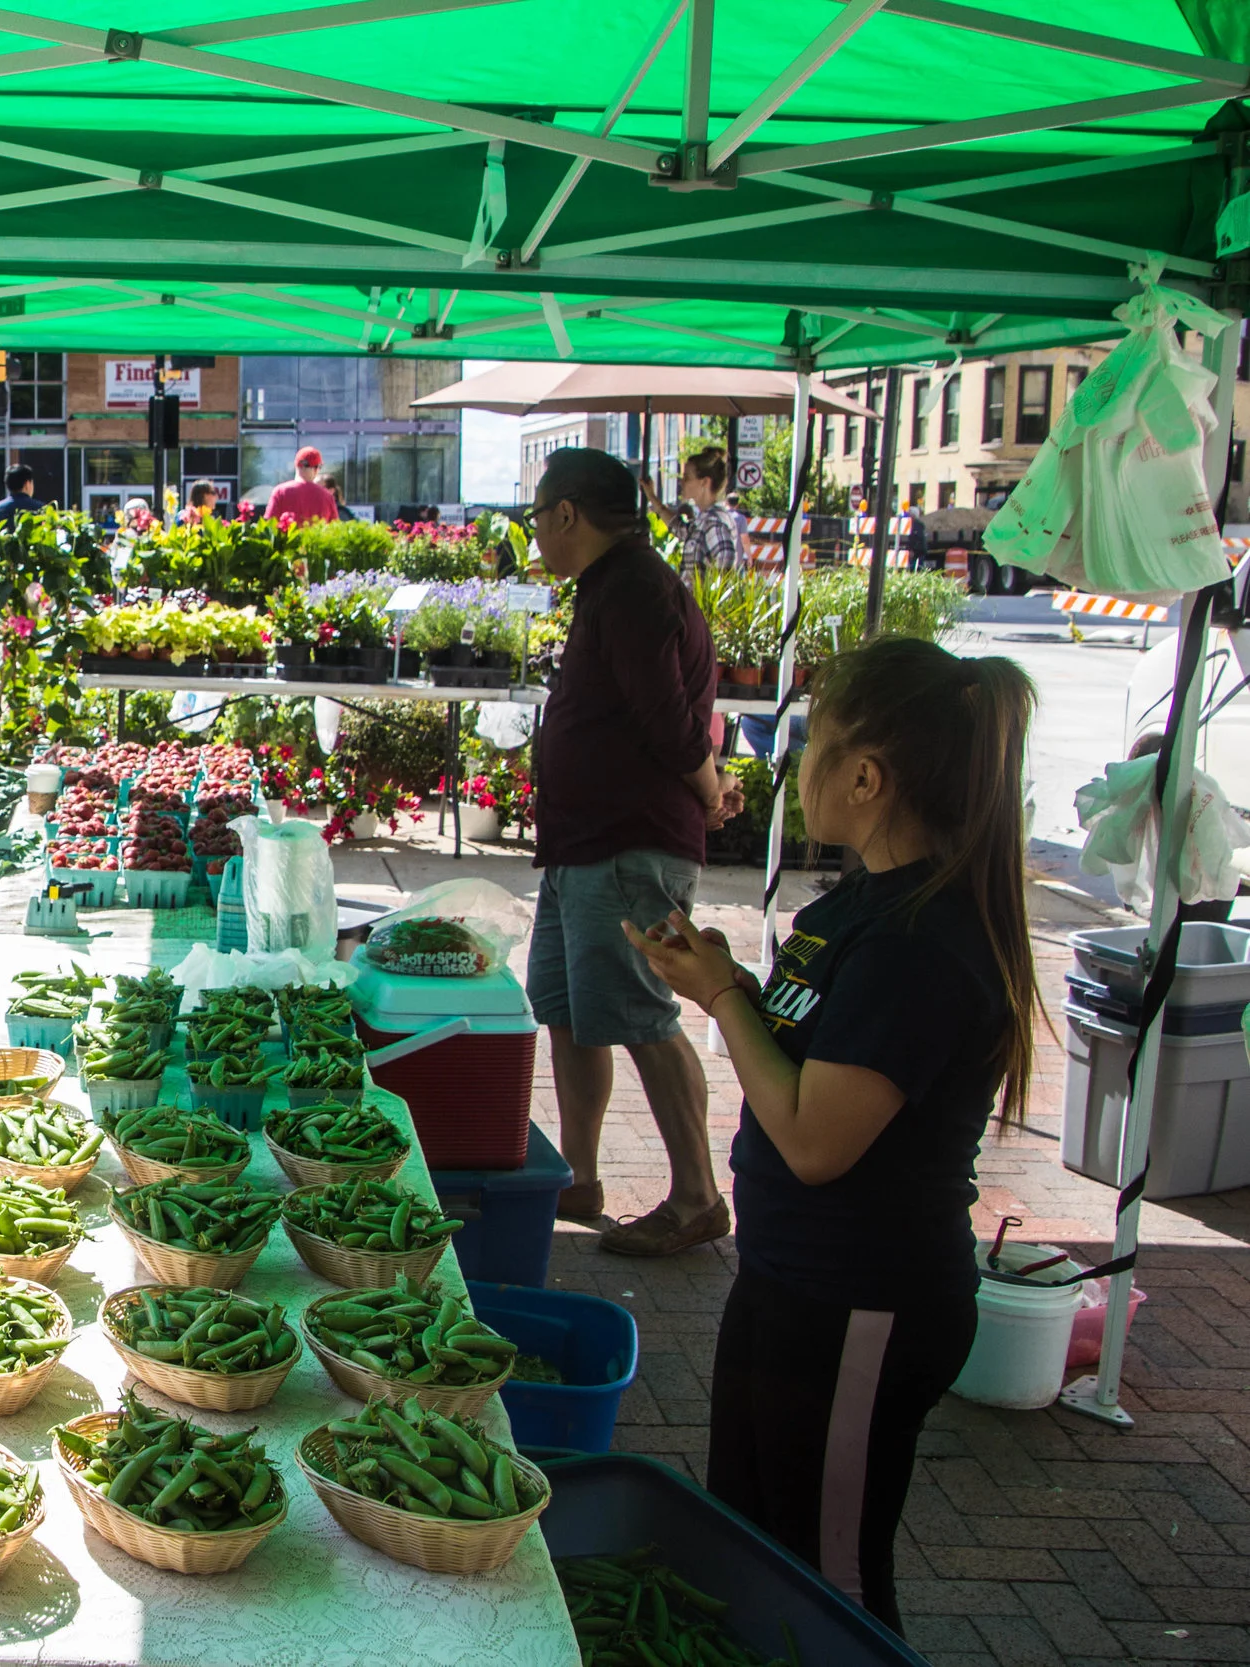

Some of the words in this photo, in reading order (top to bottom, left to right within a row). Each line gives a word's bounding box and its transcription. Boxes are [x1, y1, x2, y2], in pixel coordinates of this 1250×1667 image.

[115, 363, 190, 381] Find
[1170, 529, 1198, 545] PLEASE
[399, 952, 423, 965] HOT
[436, 951, 477, 965] SPICY
[381, 960, 431, 975] CHEESE
[433, 963, 477, 975] BREAD
